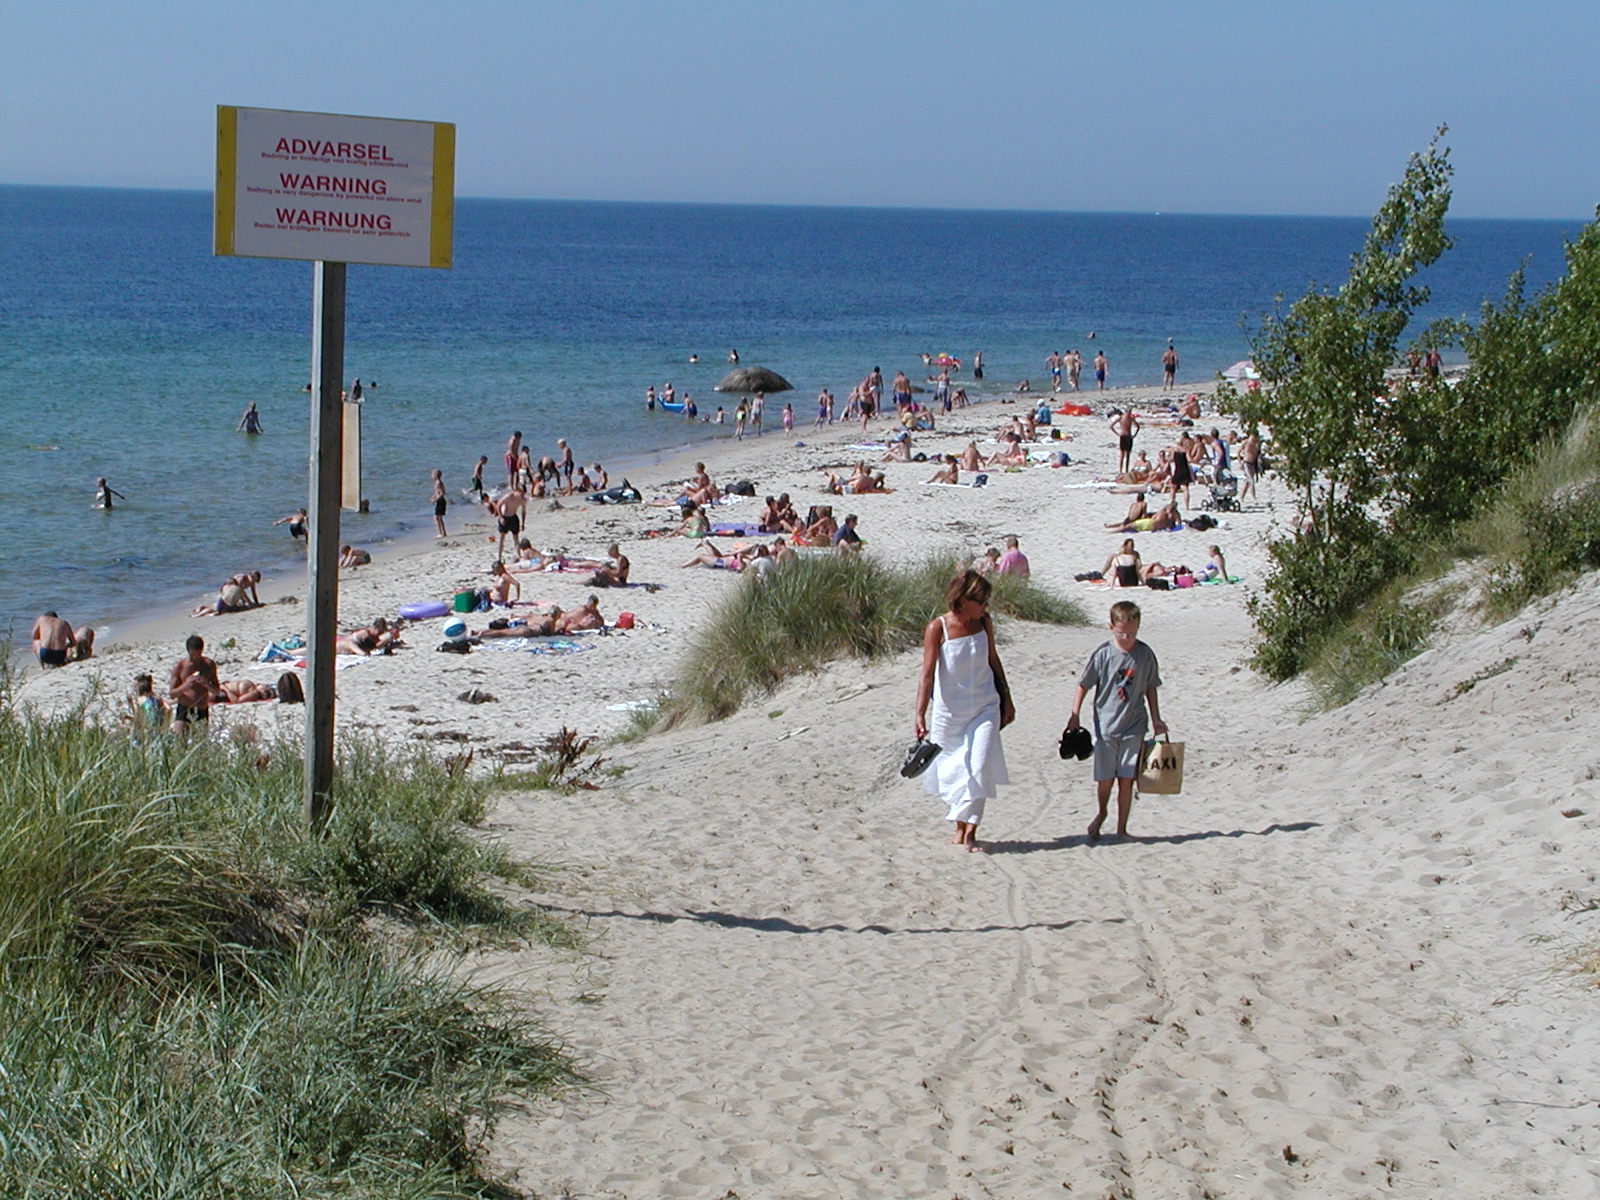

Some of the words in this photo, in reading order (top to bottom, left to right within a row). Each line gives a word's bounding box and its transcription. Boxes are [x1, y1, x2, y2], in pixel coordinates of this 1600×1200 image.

[275, 138, 393, 161] ADVARSEL
[280, 173, 387, 195] WARNING
[276, 208, 391, 231] WARNUNG
